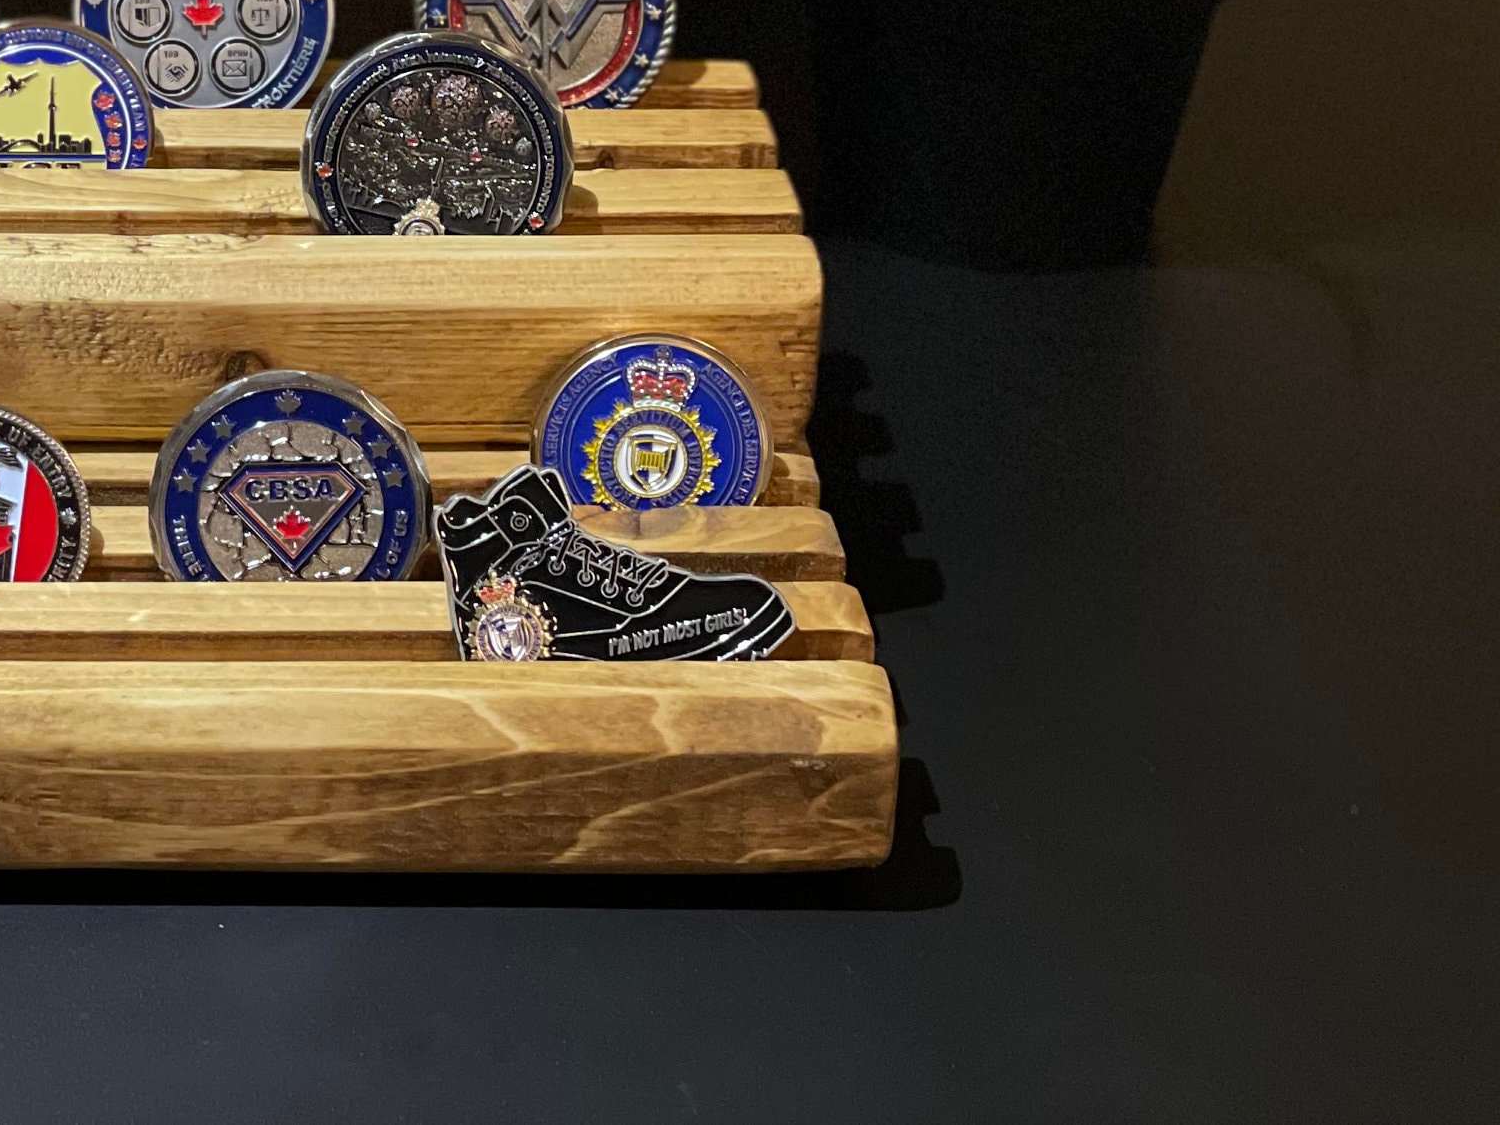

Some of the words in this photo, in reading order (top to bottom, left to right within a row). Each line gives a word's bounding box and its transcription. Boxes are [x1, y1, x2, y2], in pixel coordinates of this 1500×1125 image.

[536, 155, 555, 213] TORONTO
[569, 352, 618, 399] AGENCY
[702, 363, 747, 410] AGENCE
[2, 426, 33, 453] OF
[31, 444, 73, 499] ENTRY
[244, 478, 336, 502] CBSA
[394, 510, 409, 536] US
[50, 536, 77, 579] RITY
[608, 635, 631, 656] I'M
[632, 628, 660, 651] NOT
[662, 618, 701, 644] MOST
